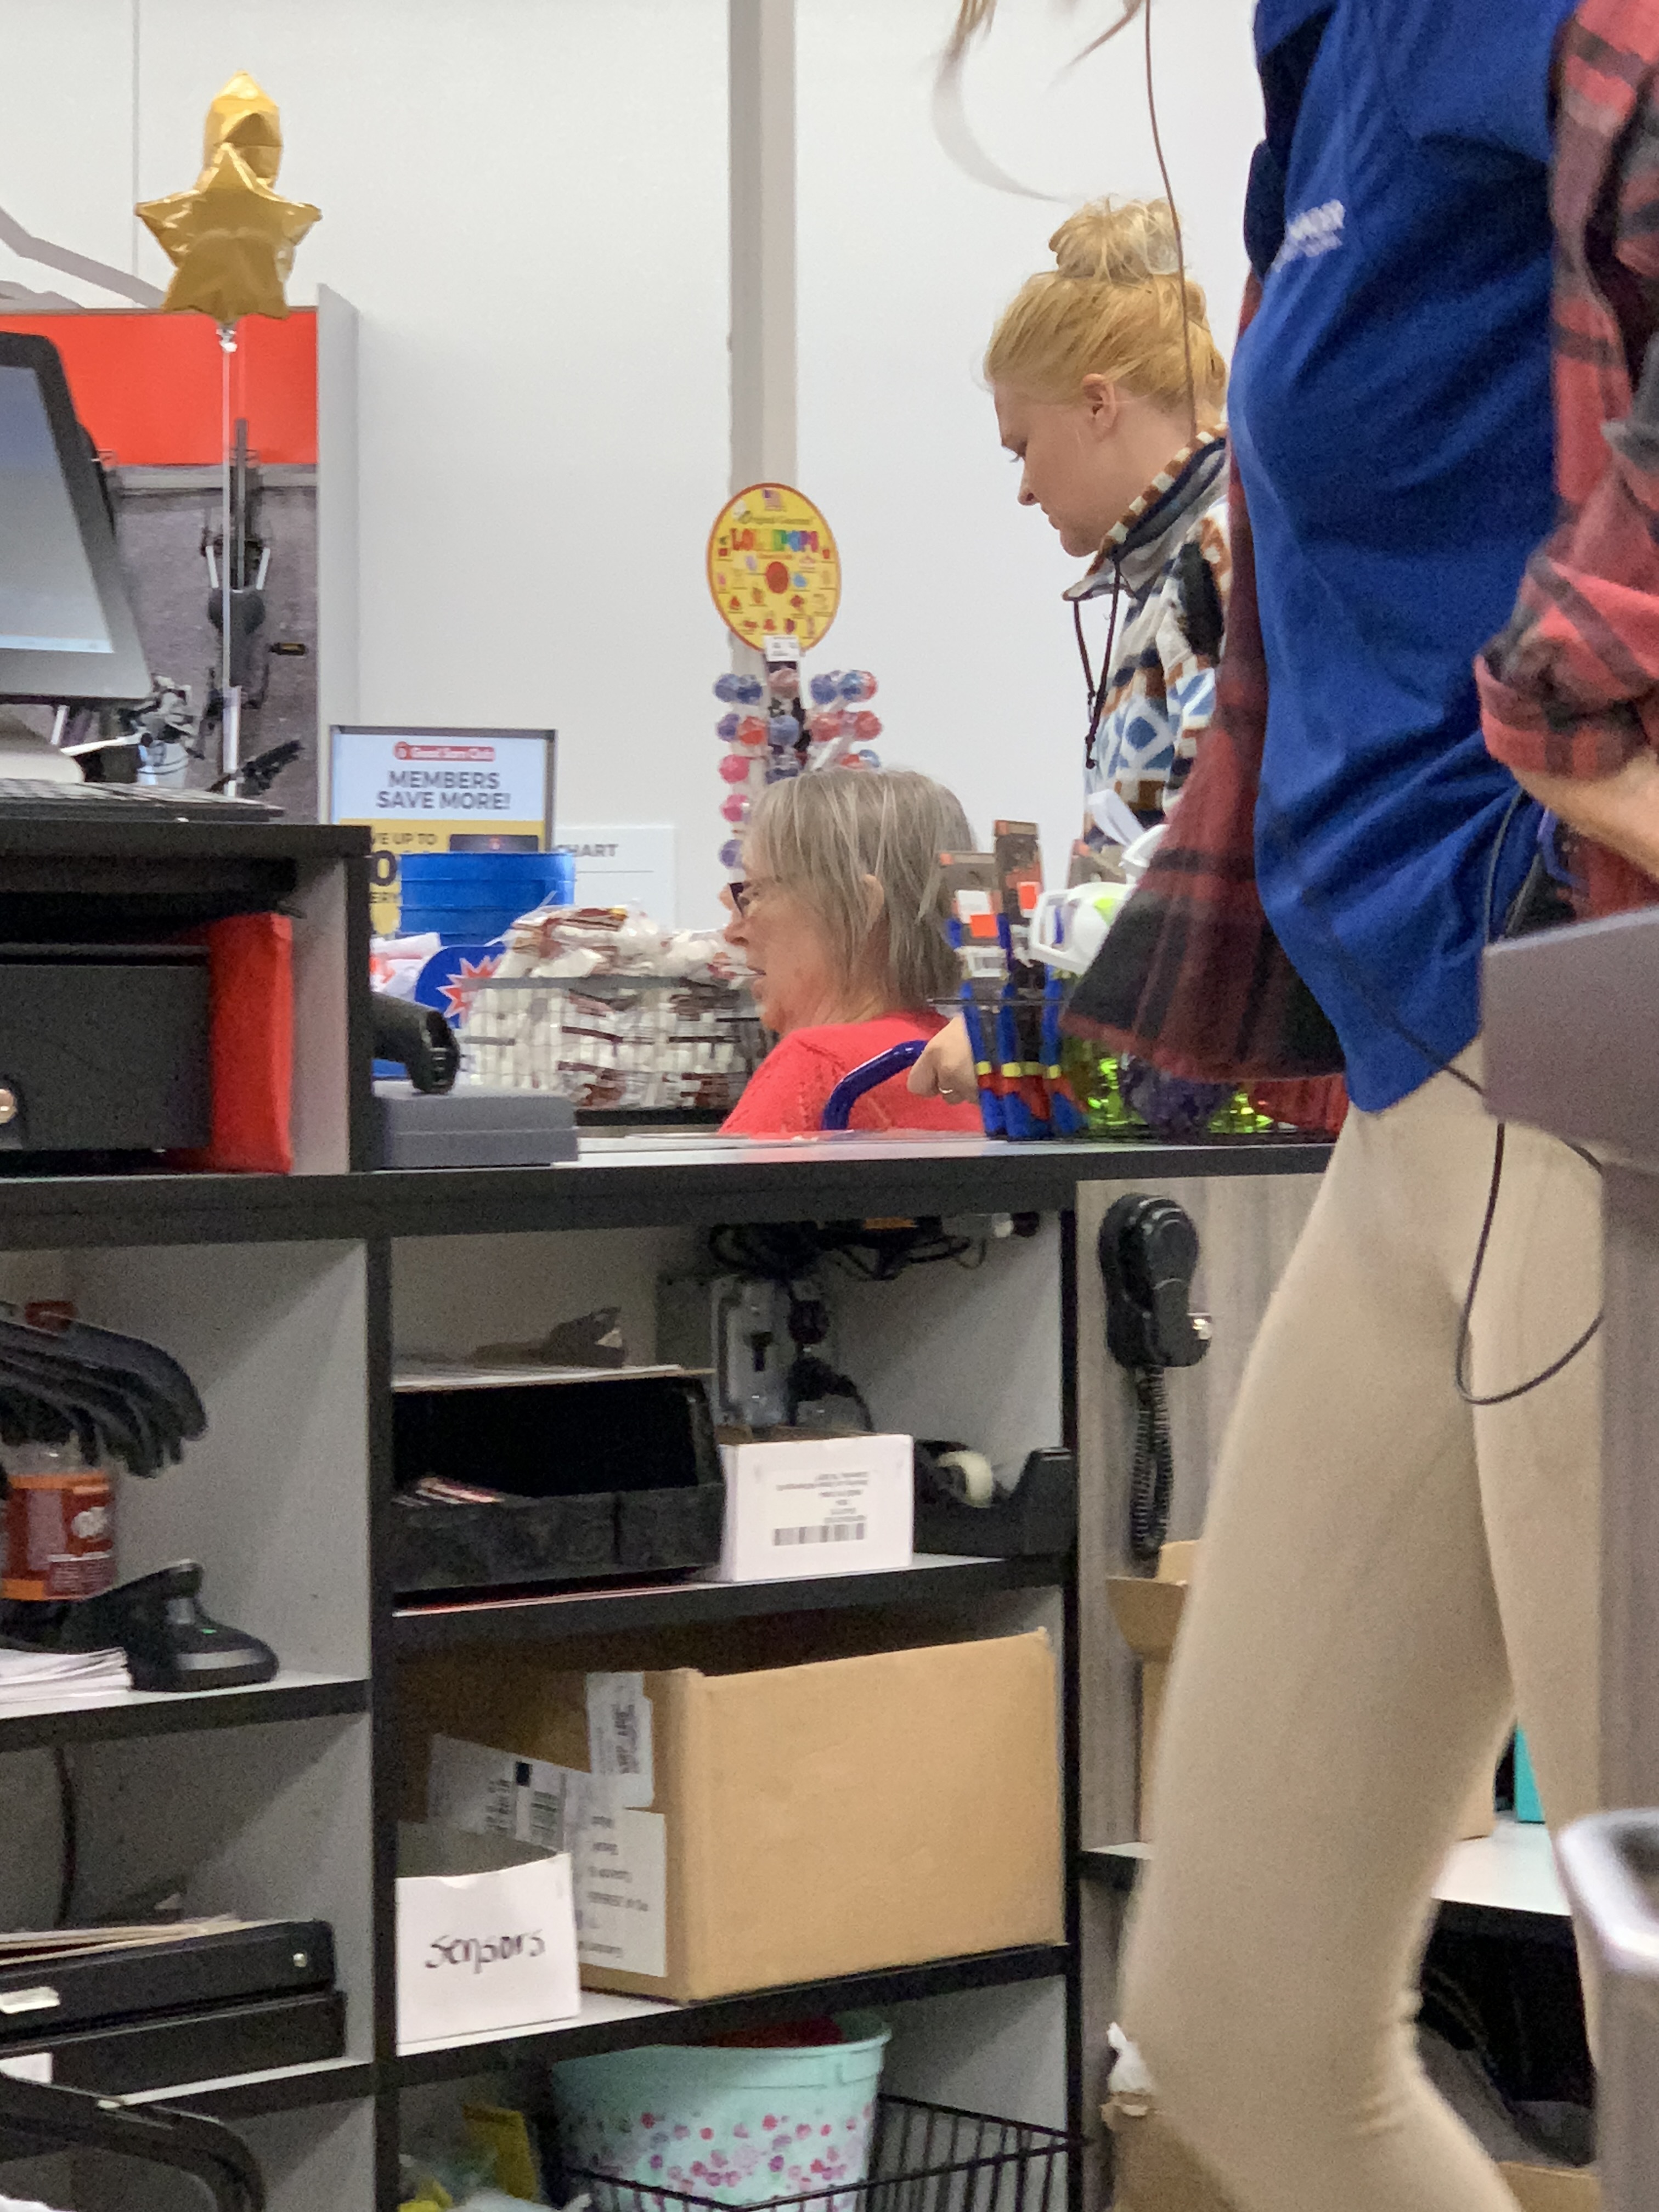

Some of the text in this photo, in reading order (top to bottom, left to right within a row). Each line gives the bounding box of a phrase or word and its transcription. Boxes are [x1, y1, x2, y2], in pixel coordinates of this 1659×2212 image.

[388, 770, 500, 789] MEMBERS
[376, 791, 511, 810] SAVE MORE!
[393, 833, 413, 845] UP
[417, 833, 437, 845] TO
